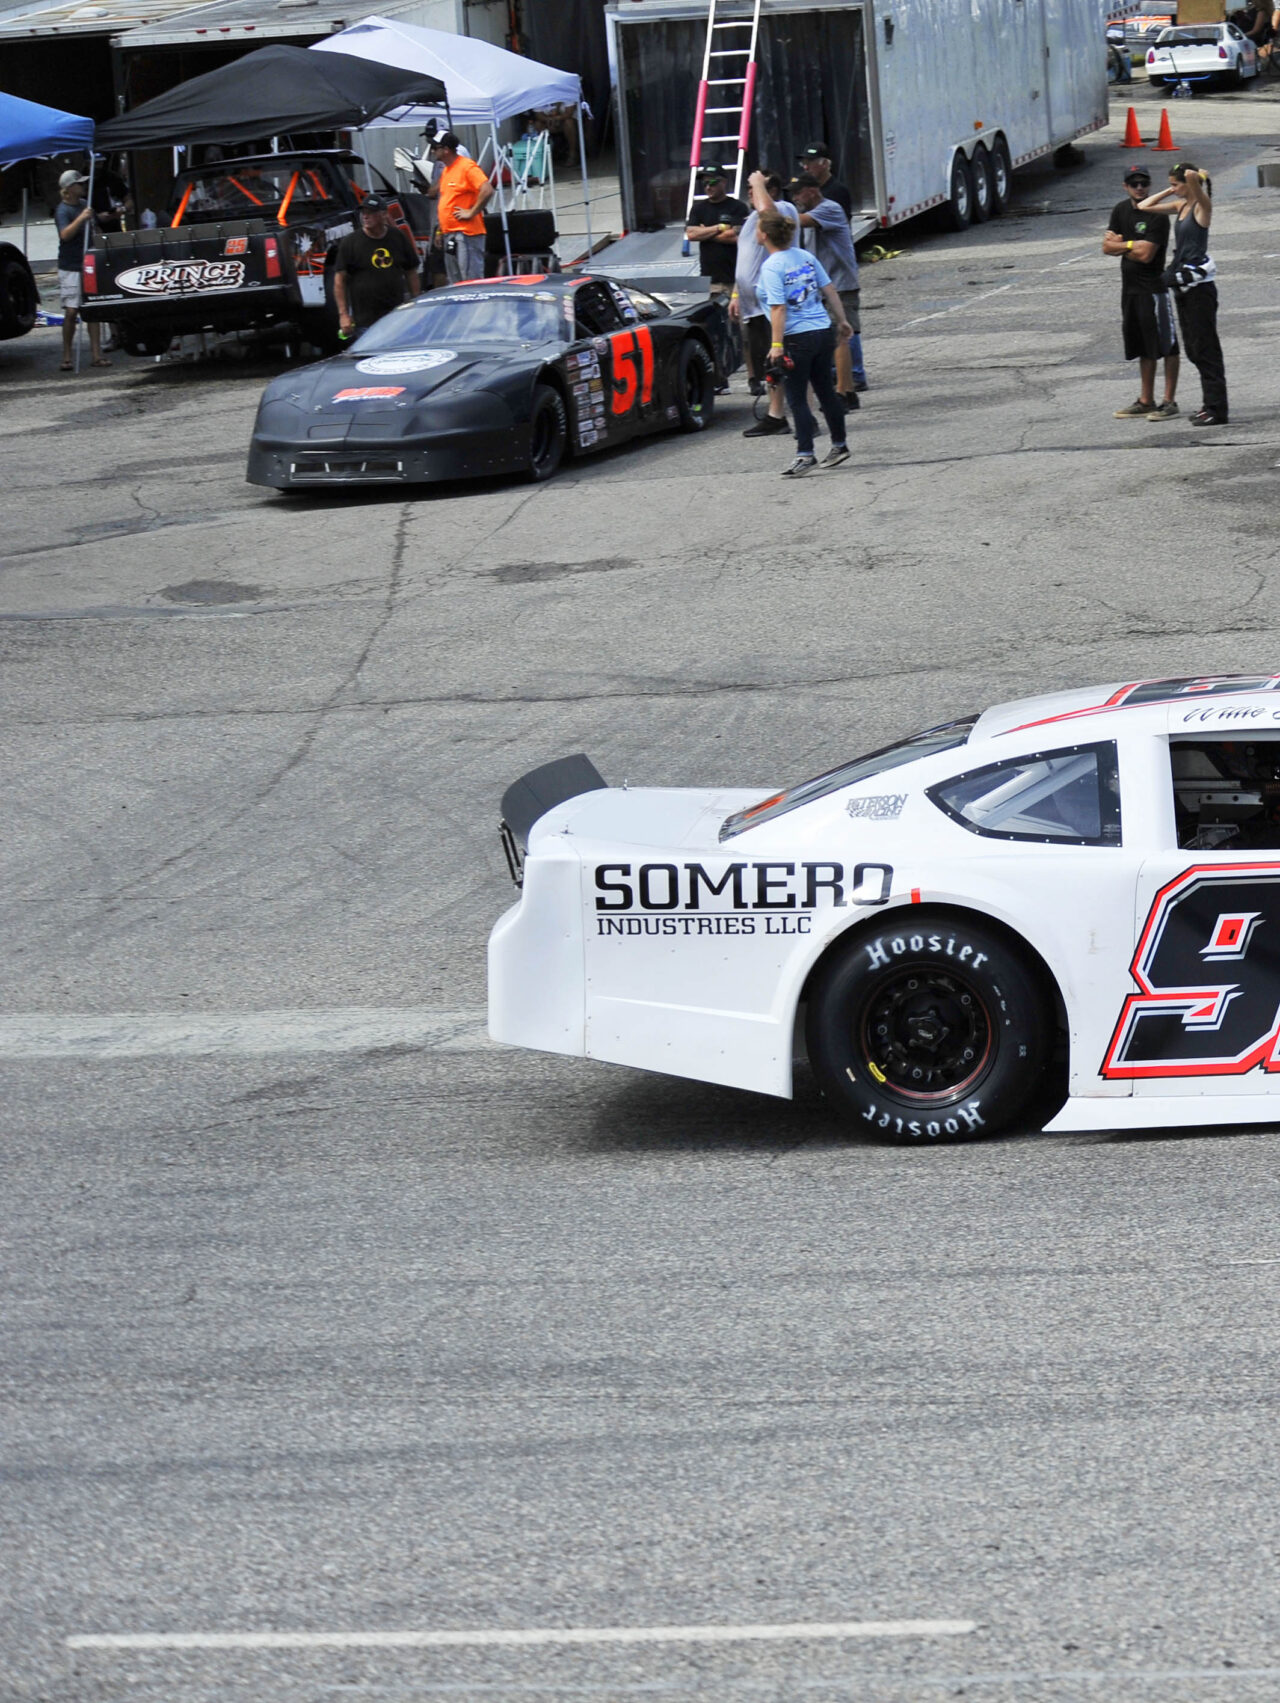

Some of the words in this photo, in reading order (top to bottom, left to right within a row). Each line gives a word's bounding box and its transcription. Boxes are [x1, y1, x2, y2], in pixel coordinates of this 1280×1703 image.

[136, 262, 241, 286] PRINCE
[610, 324, 654, 416] 51
[594, 861, 895, 911] SOMERO
[597, 916, 756, 936] INDUSTRIES
[765, 916, 813, 935] LLC
[864, 932, 989, 971] Hoosier
[861, 1100, 987, 1137] Hoosier
